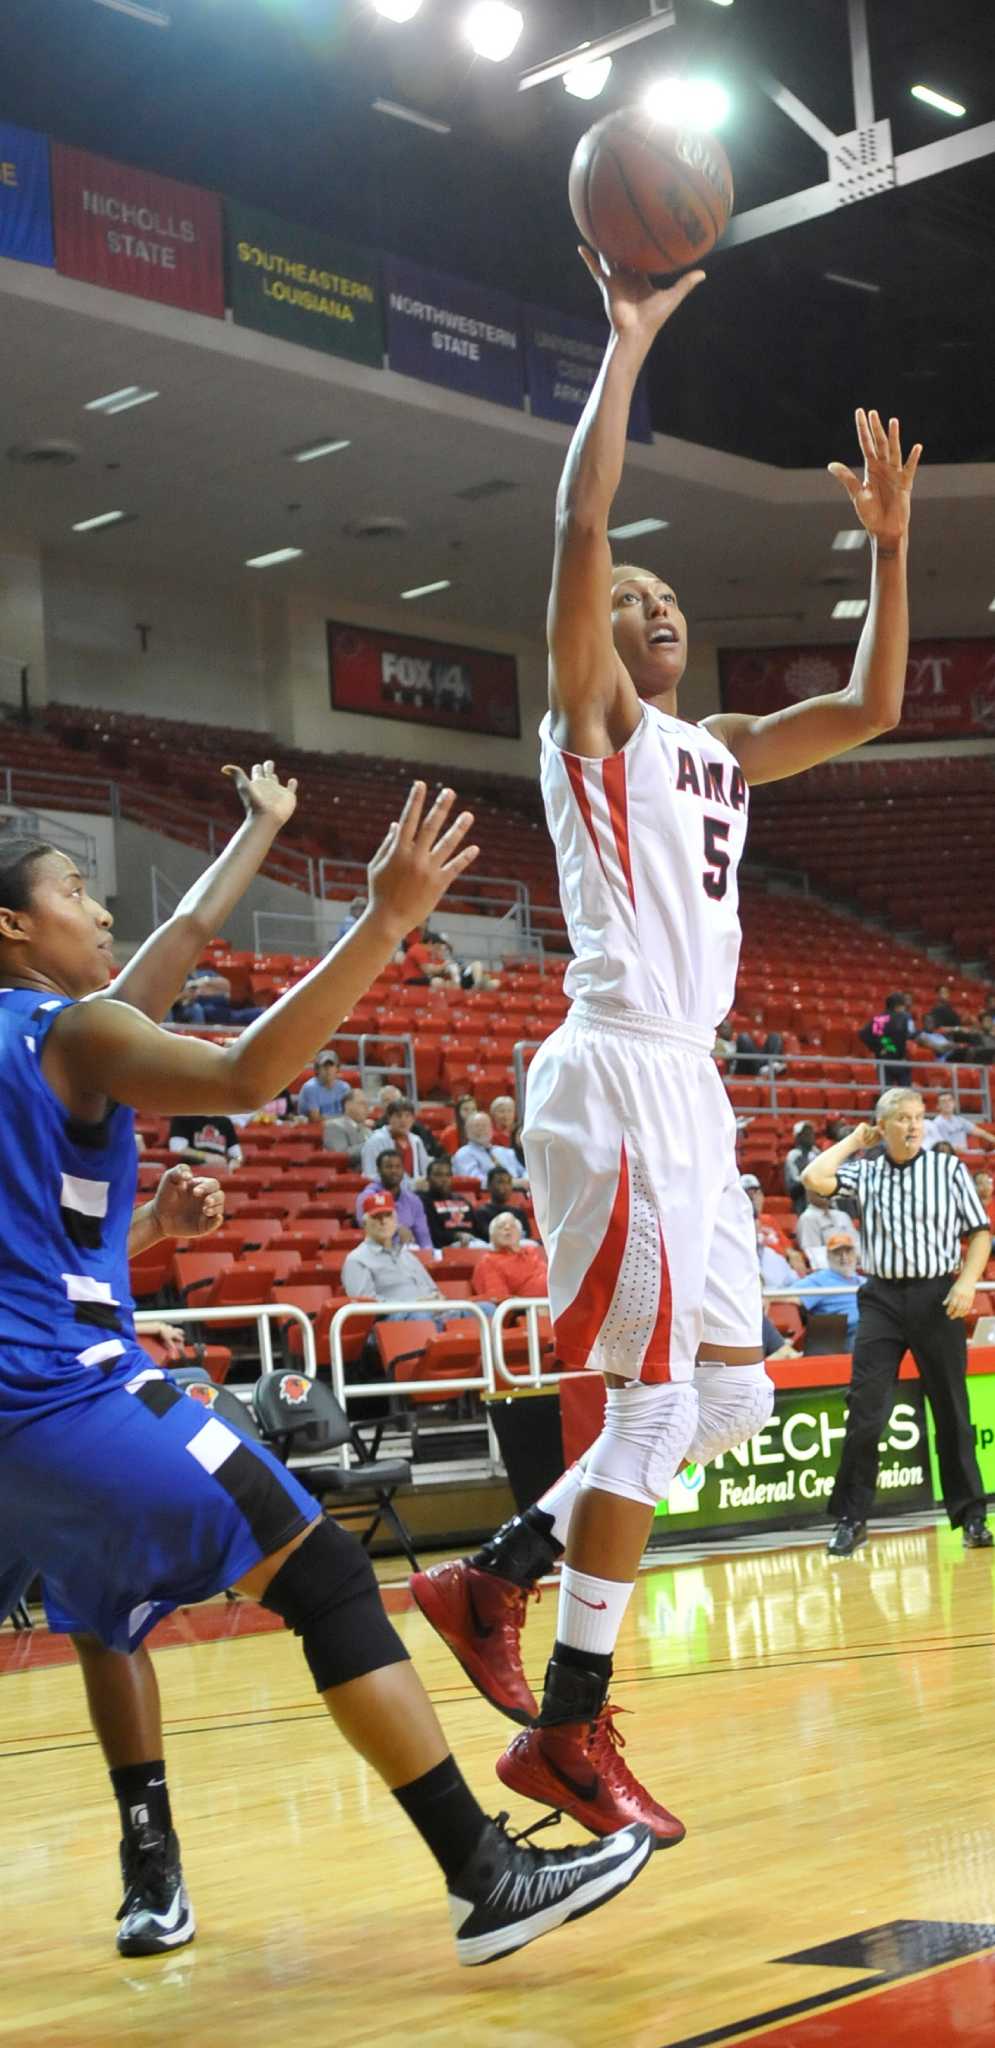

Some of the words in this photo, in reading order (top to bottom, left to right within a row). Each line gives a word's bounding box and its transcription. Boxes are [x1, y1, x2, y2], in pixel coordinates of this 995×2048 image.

[82, 189, 194, 242] NICHOLLS
[106, 230, 177, 269] STATE
[237, 241, 374, 304] SOUTHEASTERN
[263, 277, 354, 322] LOUISIANA
[389, 293, 517, 349] NORTHWESTERN
[431, 331, 480, 361] STATE
[381, 651, 434, 690] FOX
[702, 814, 731, 902] 5
[714, 1403, 920, 1469] NECHS
[717, 1469, 796, 1509] Federal
[798, 1468, 836, 1498] Cre
[876, 1461, 924, 1489] nion
